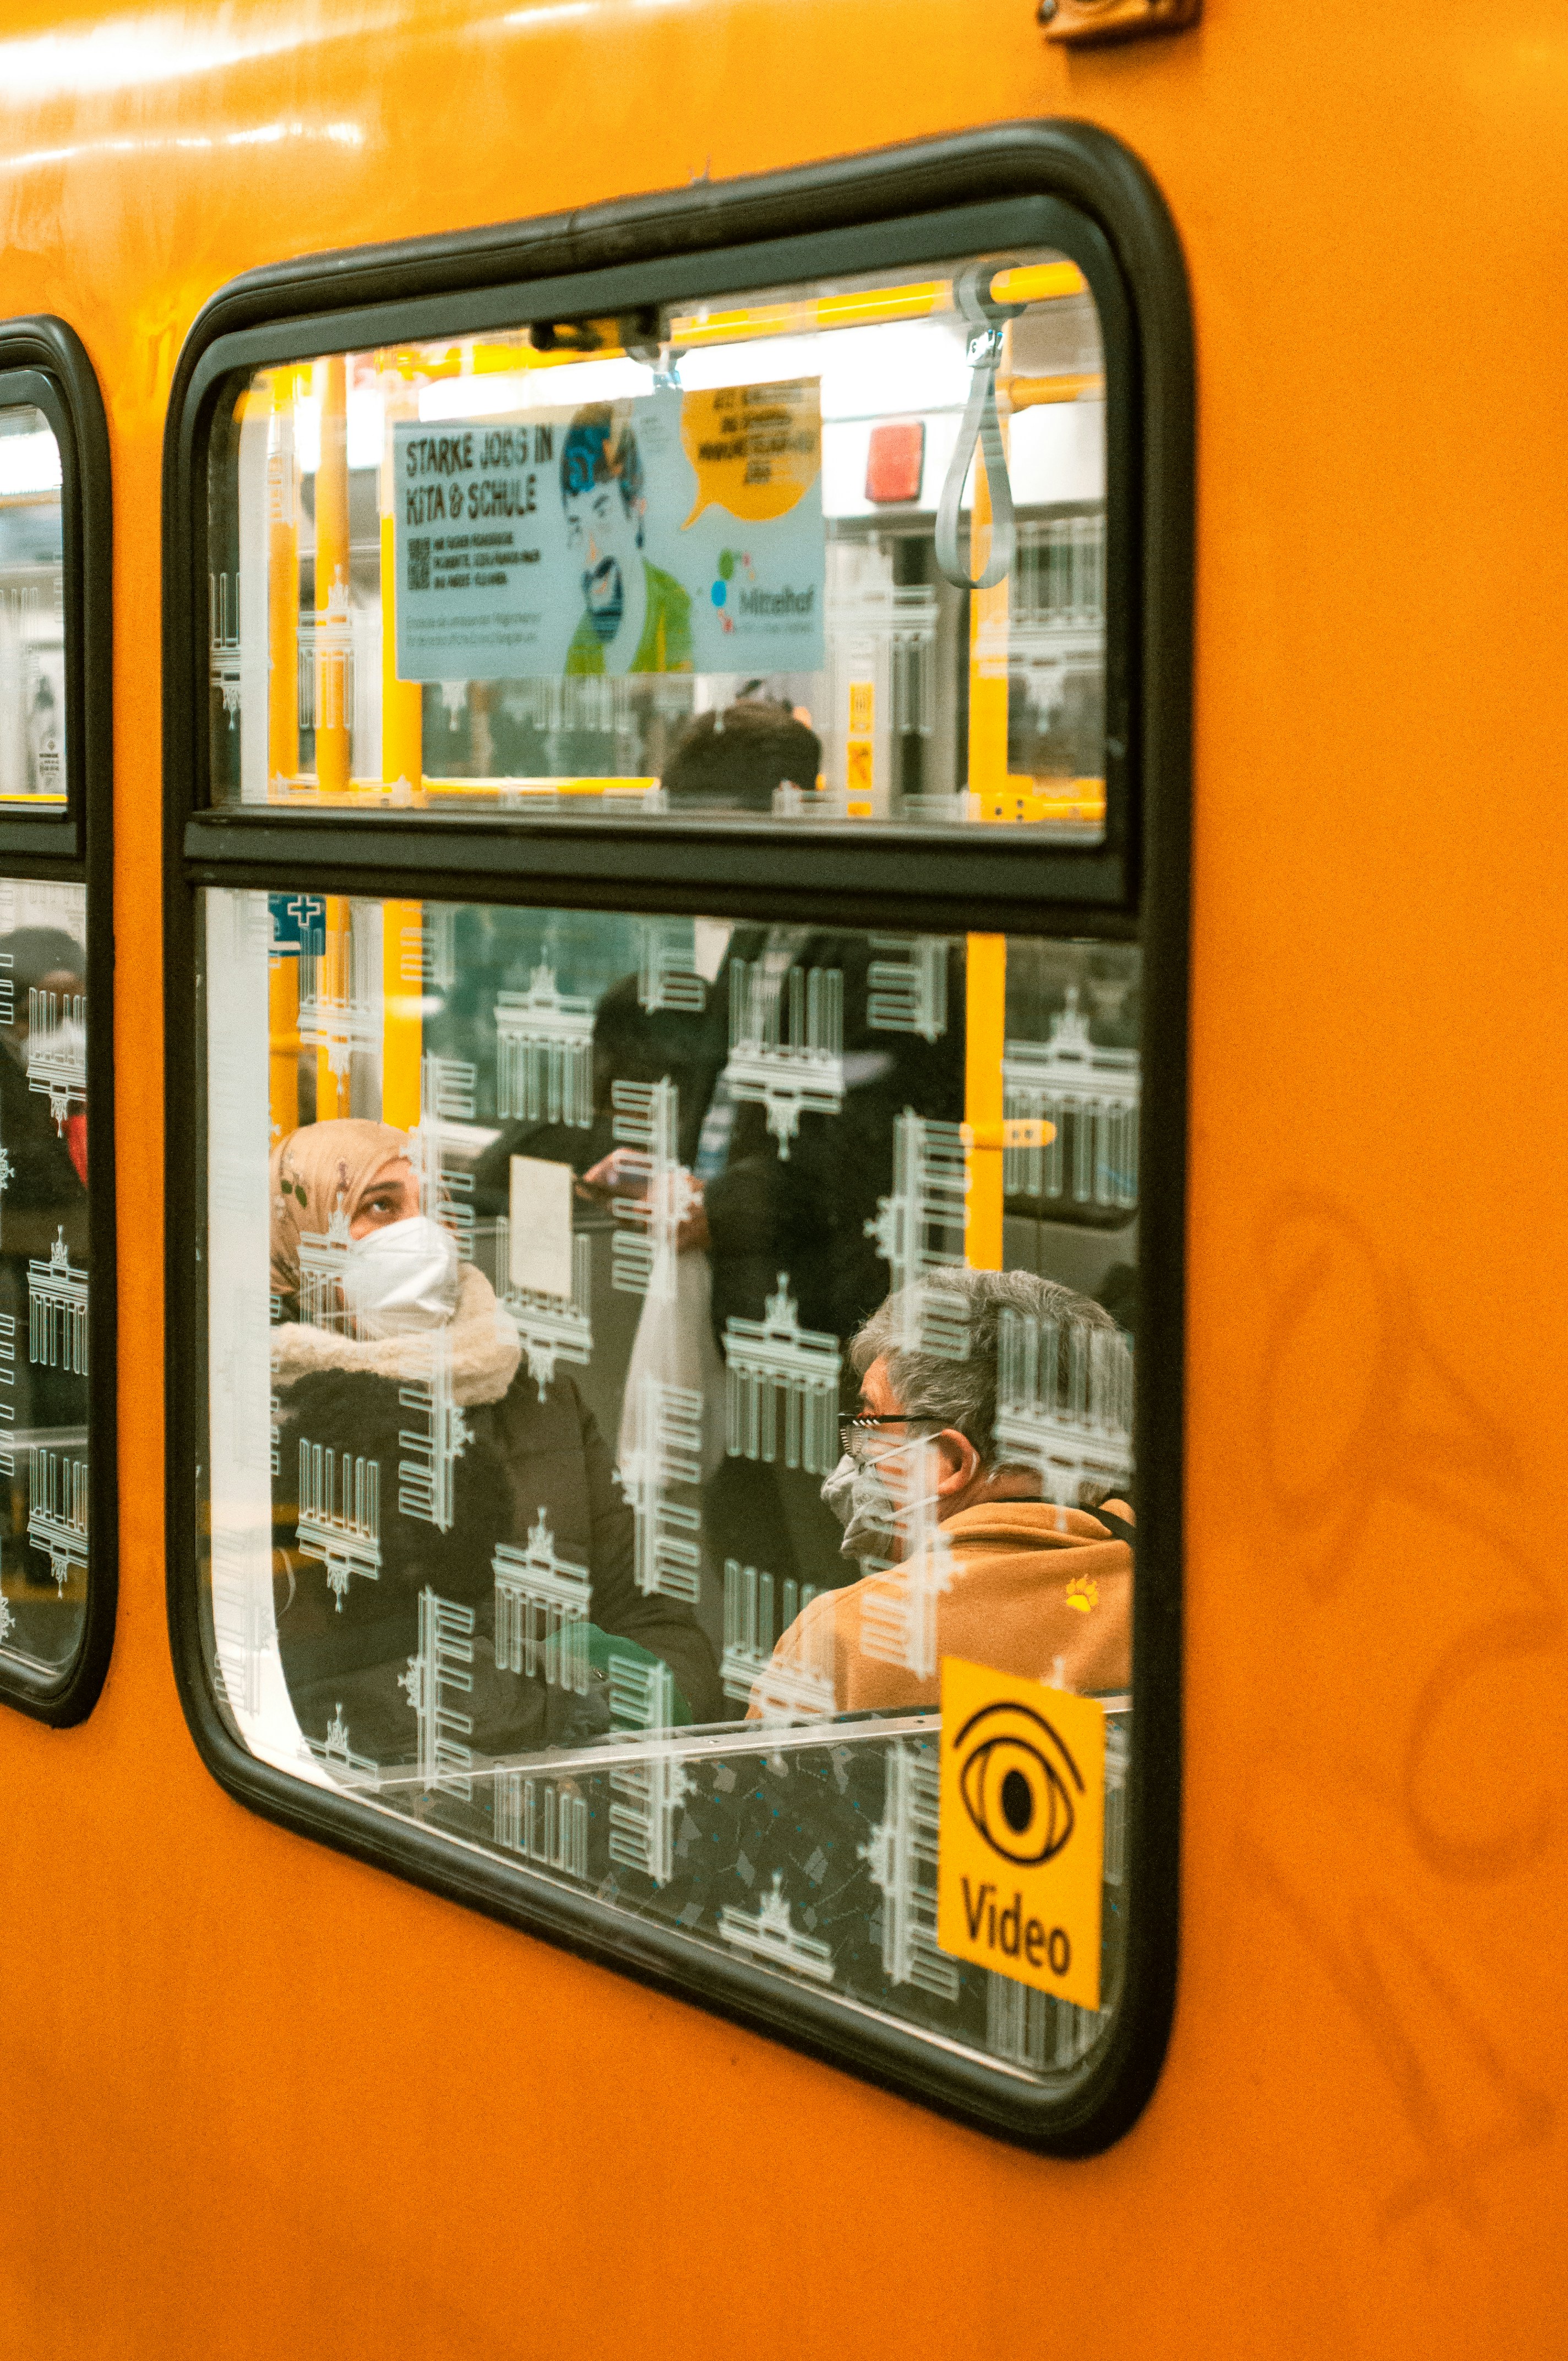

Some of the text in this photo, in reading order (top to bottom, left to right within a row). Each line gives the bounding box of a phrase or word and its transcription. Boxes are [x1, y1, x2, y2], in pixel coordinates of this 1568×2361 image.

[406, 422, 553, 478] STARKE JOBS IN
[406, 474, 537, 526] KITA & SCHULE
[961, 1874, 1071, 1977] Video
